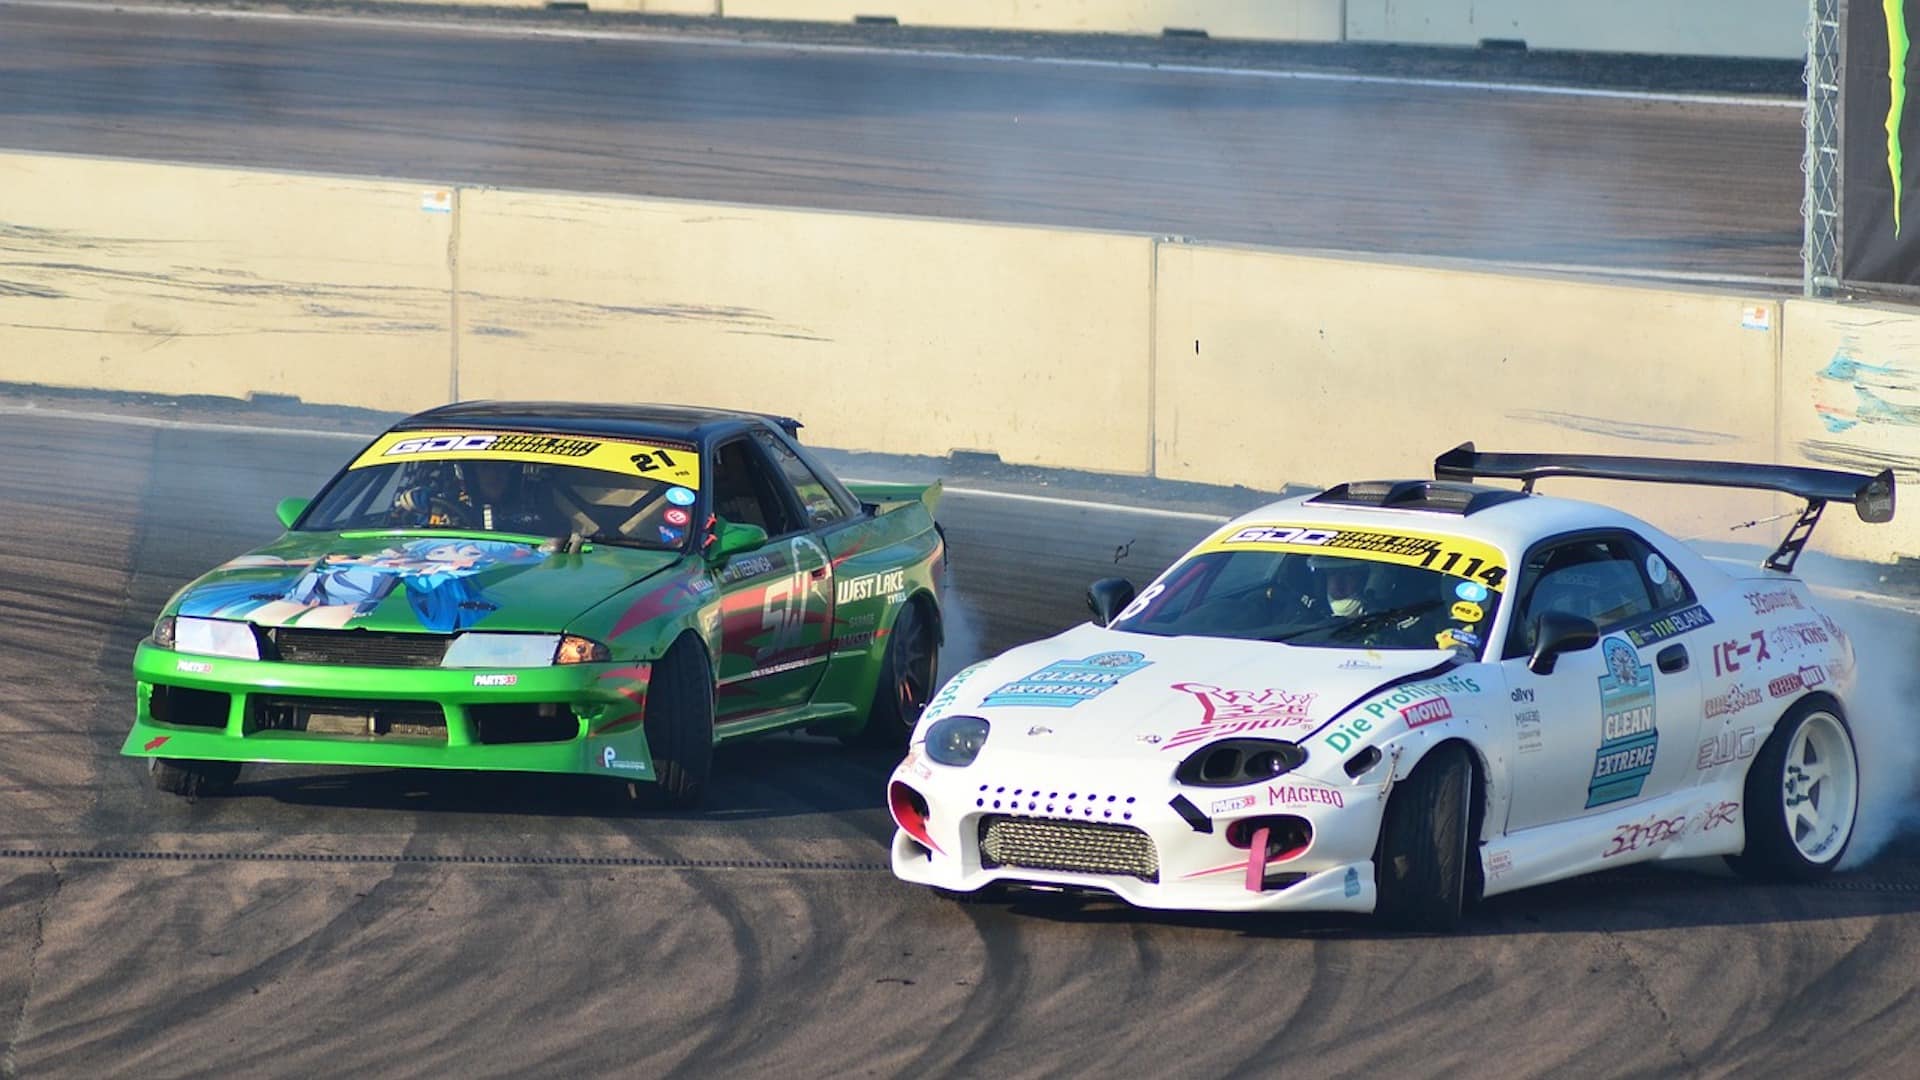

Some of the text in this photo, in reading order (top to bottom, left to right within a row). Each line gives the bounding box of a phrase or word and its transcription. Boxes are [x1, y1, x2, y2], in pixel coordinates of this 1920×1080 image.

[630, 450, 676, 472] 21
[1420, 549, 1507, 587] 1114
[836, 567, 904, 605] WEST LAKE
[1670, 608, 1710, 631] BLANK
[993, 684, 1105, 696] EXTREME
[1027, 671, 1121, 684] CLEAN
[1405, 699, 1451, 725] MOTUL
[1605, 707, 1652, 740] CLEAN
[1325, 717, 1373, 754] Die
[1594, 743, 1655, 778] EXTREME
[1268, 785, 1344, 808] MAGEBO
